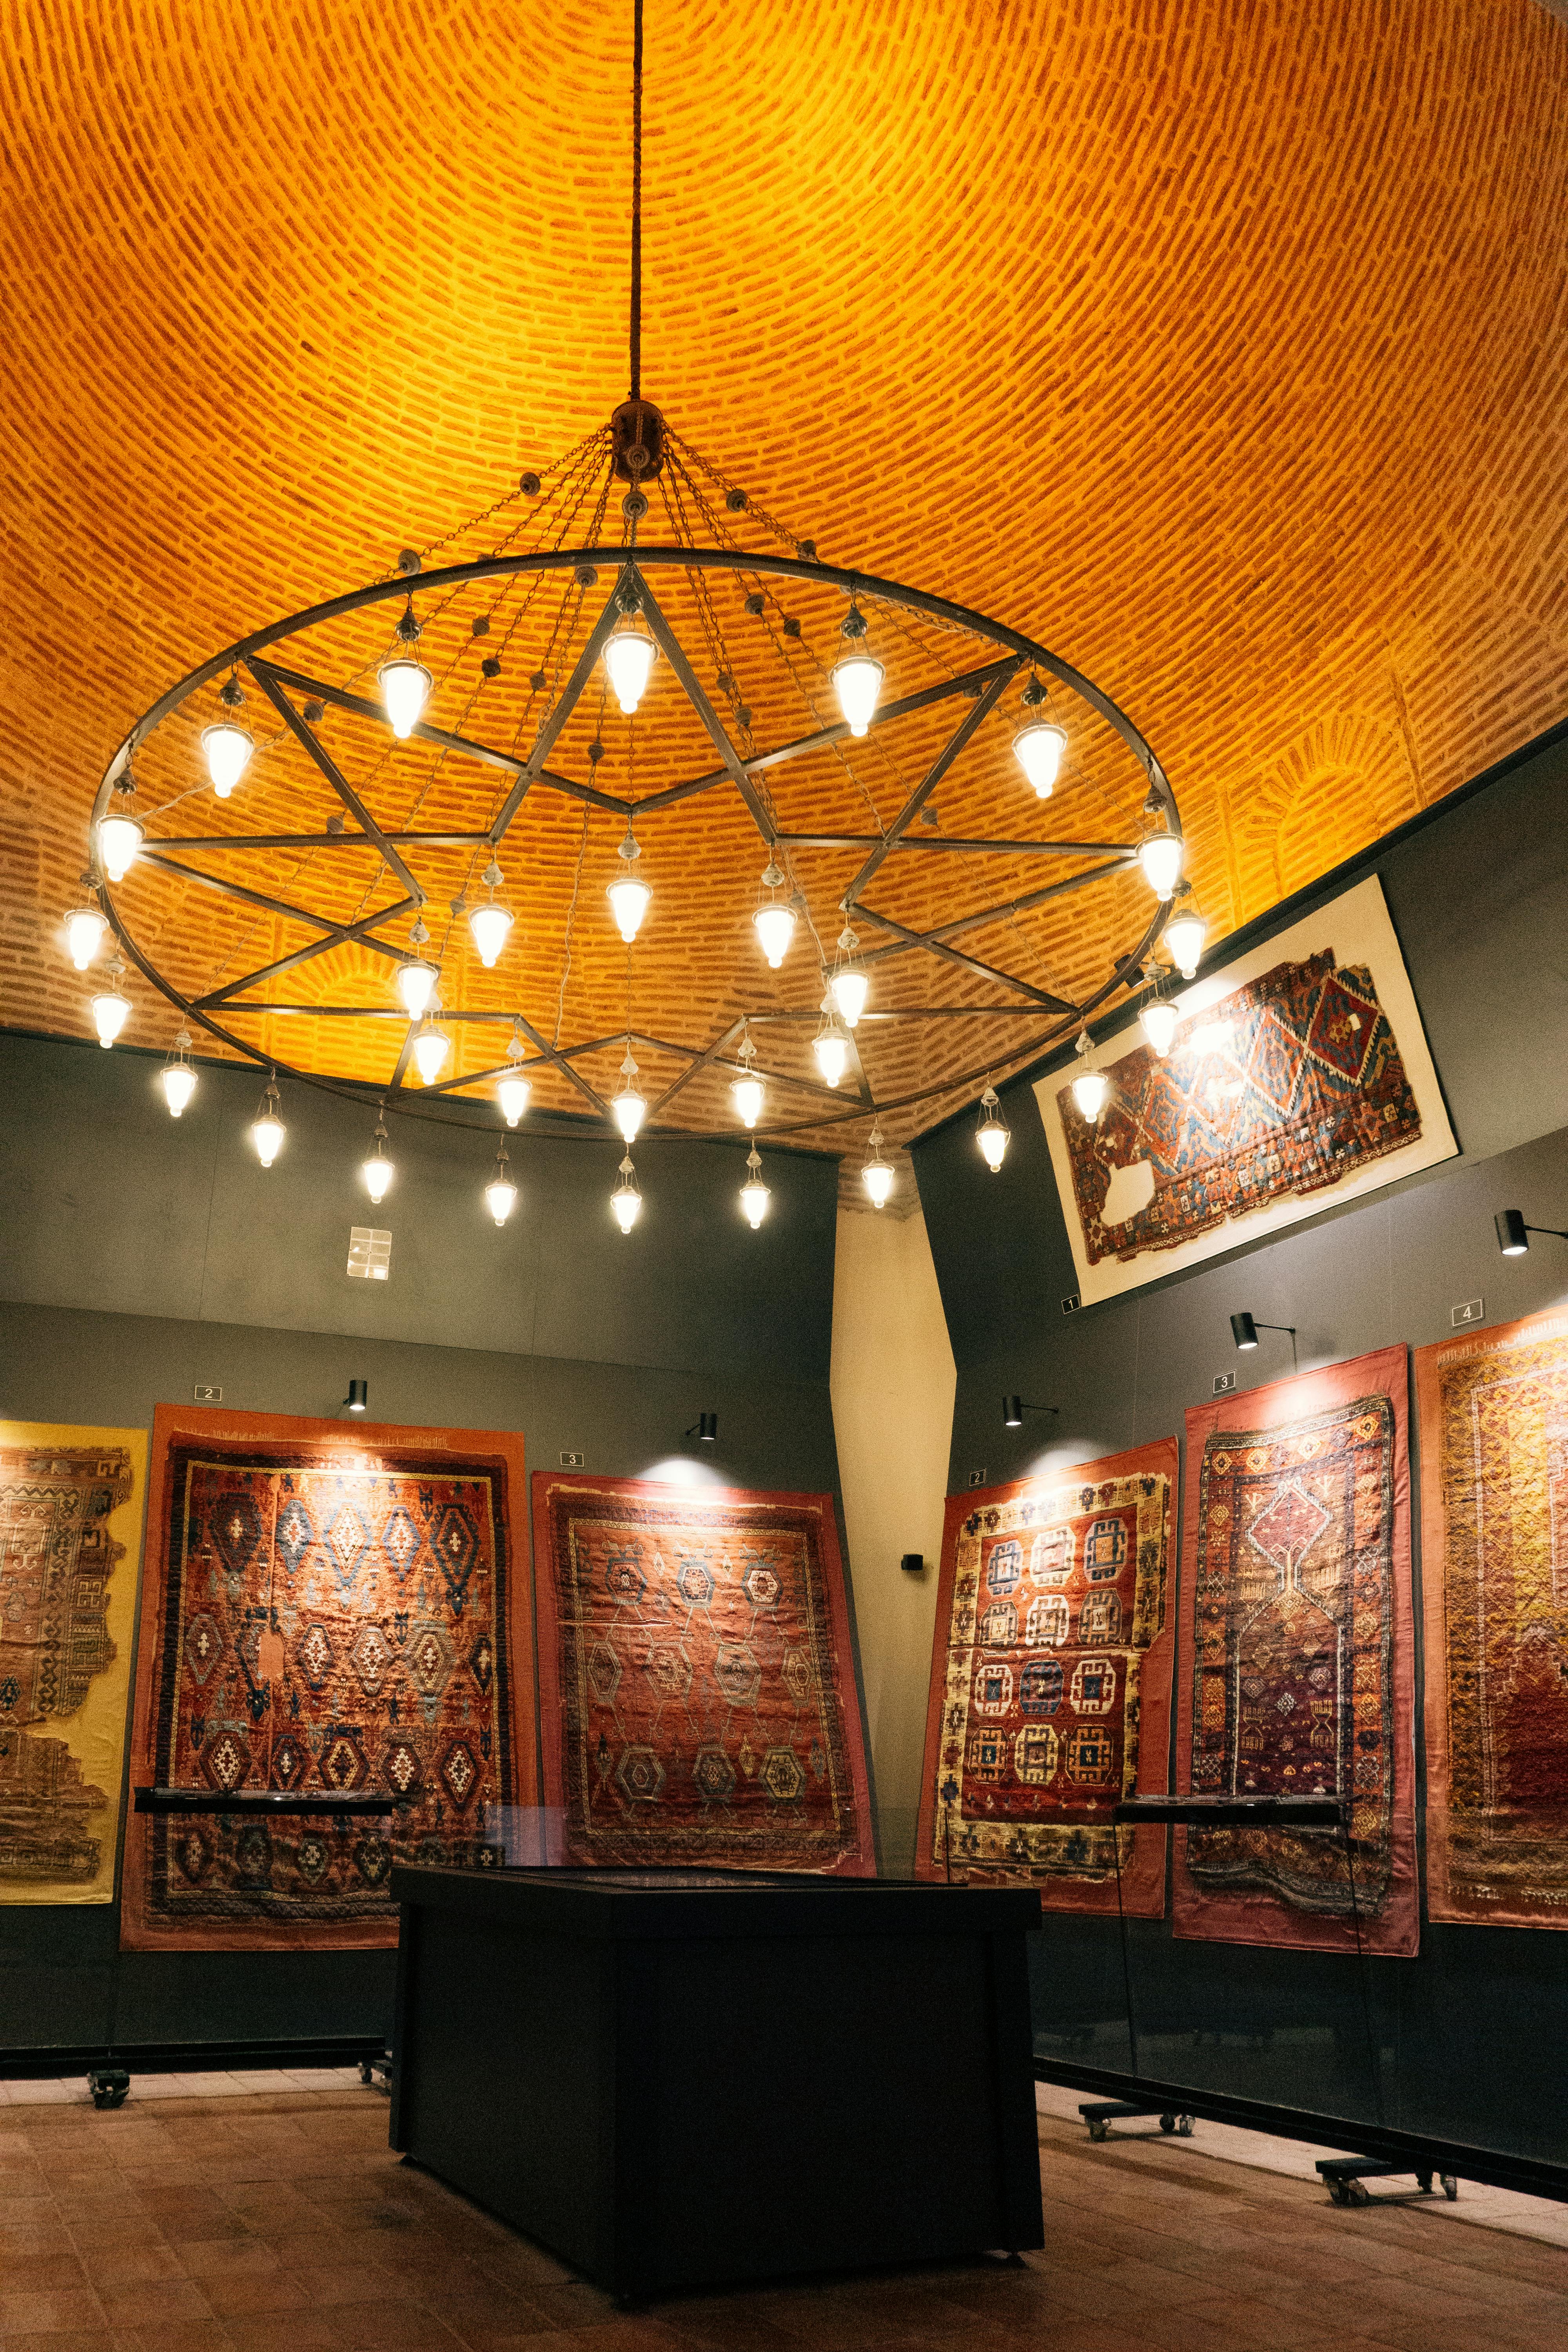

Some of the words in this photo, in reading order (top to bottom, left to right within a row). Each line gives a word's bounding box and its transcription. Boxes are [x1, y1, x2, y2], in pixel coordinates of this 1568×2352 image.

[1069, 1299, 1073, 1309] 1
[1463, 1306, 1472, 1319] 4
[1221, 1376, 1228, 1388] 3
[205, 1388, 212, 1398] 2
[569, 1454, 576, 1464] 3
[975, 1473, 980, 1483] 2
